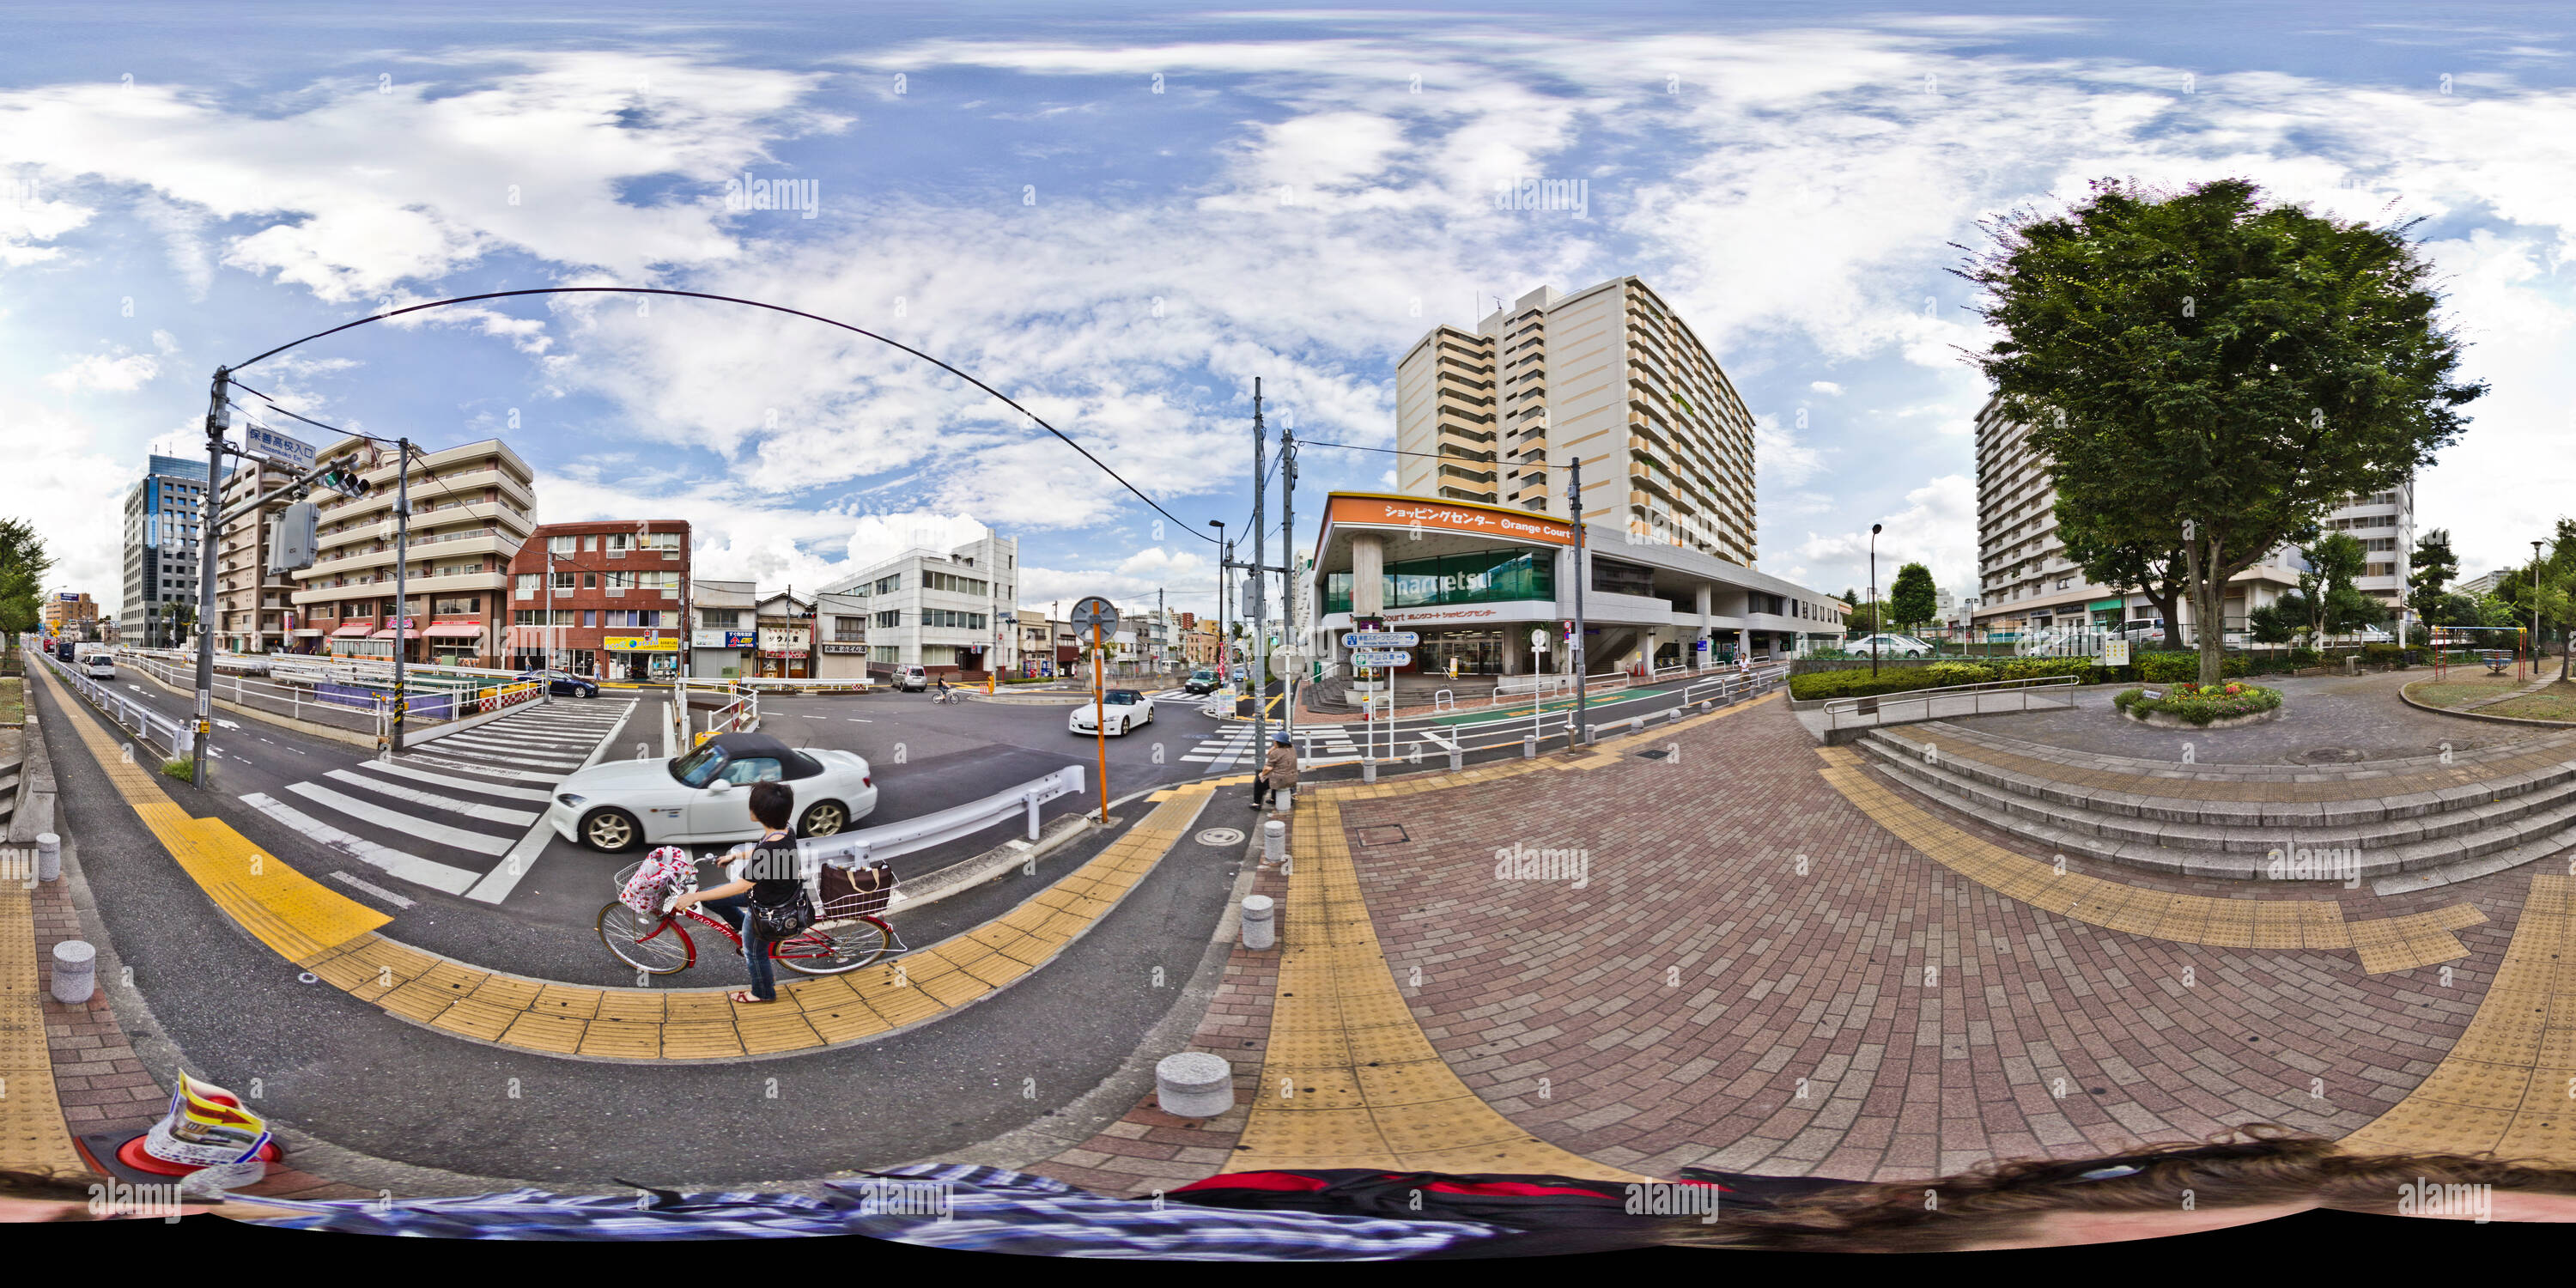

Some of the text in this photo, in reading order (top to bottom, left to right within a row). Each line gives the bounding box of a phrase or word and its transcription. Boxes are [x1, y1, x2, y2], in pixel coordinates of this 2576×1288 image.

[250, 428, 313, 459] 保善高校入口
[1385, 505, 1496, 526] ショッピングセンター
[1501, 518, 1571, 539] Orange Court
[1390, 570, 1492, 596] maruetsu
[1407, 610, 1497, 621] オレンジコート ショッピングセンター
